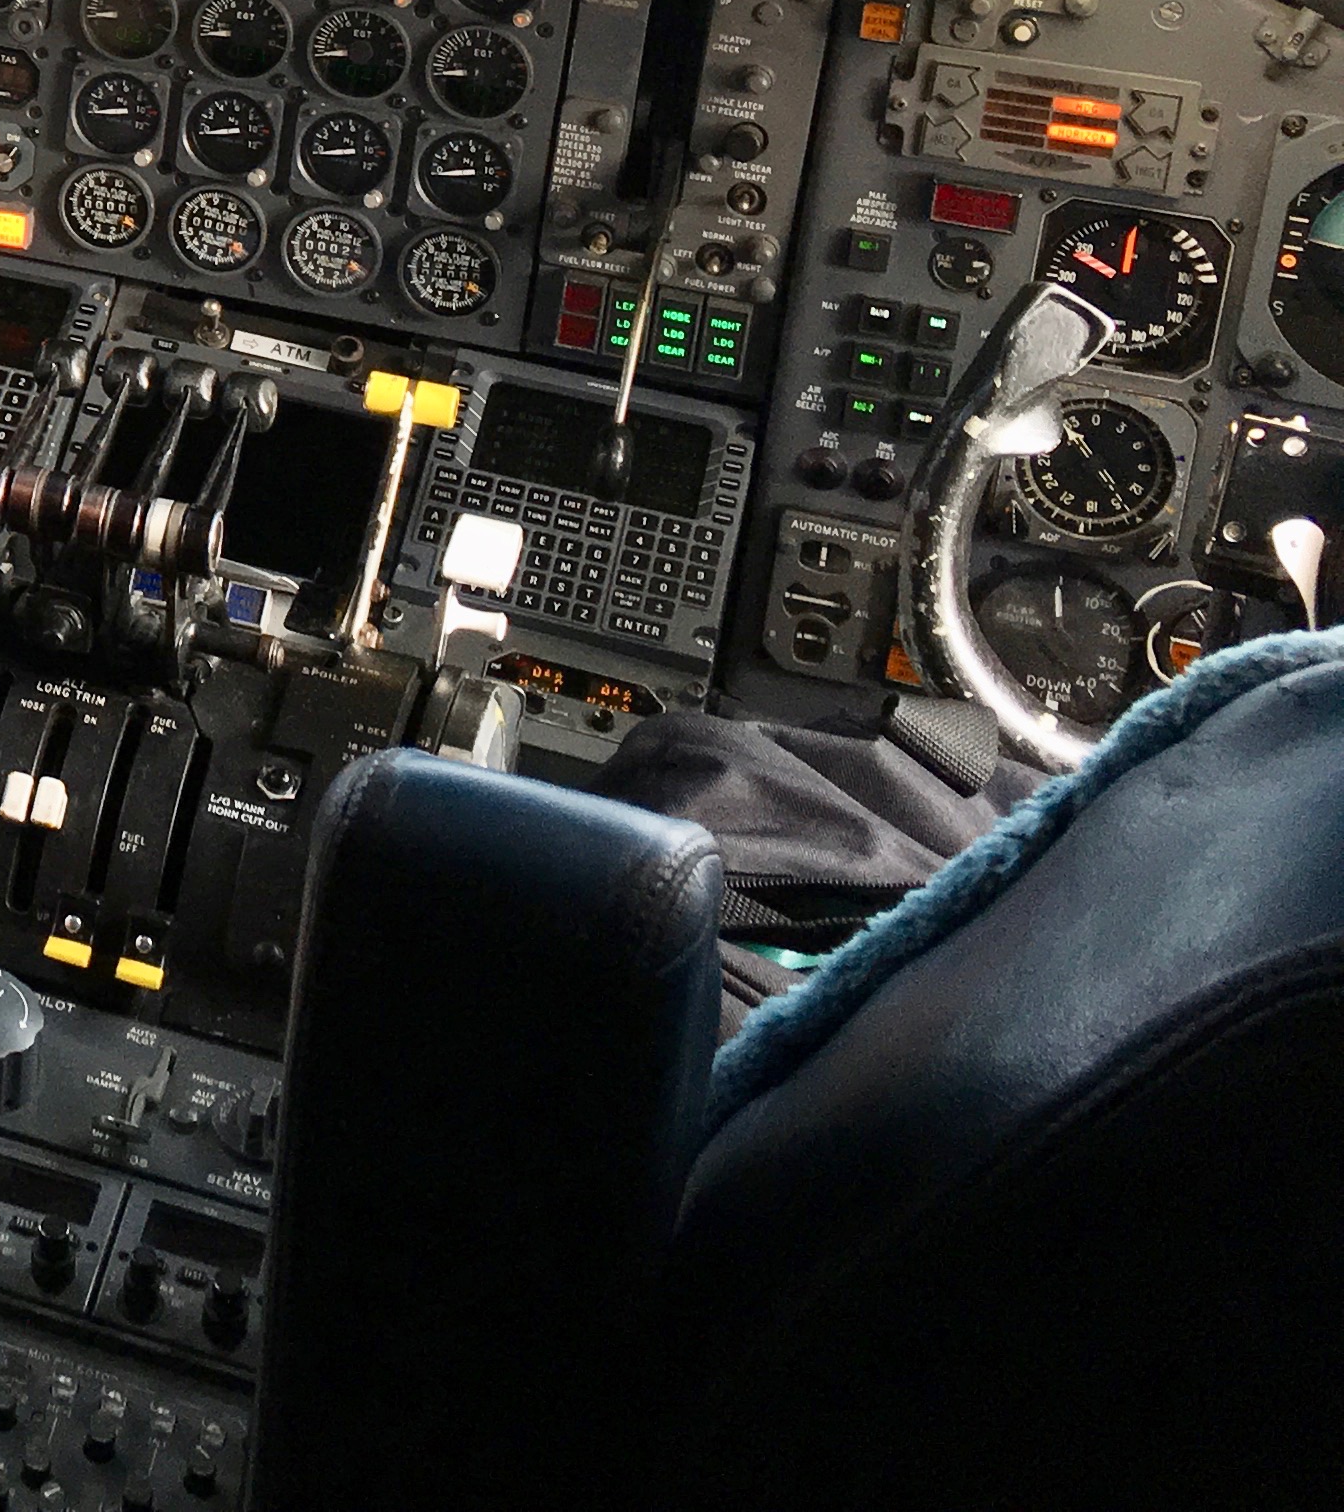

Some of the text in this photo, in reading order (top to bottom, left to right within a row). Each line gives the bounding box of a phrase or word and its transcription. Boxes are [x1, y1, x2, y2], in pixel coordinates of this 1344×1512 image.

[737, 100, 764, 111] LATCH
[718, 107, 756, 120] RELEASE
[561, 123, 577, 131] MAX
[559, 131, 590, 143] EXTEND
[1057, 127, 1107, 142] HORIZON
[558, 139, 584, 150] SPEED
[552, 175, 573, 185] OVER
[734, 171, 767, 183] UNSAFE
[868, 191, 887, 201] MAX
[856, 198, 897, 211] AIRSPEED
[856, 206, 895, 220] WARNING
[718, 215, 766, 231] LIGHT TEST
[702, 230, 735, 243] NORMAL
[673, 248, 693, 258] LEFT
[1075, 242, 1093, 254] 350
[559, 254, 578, 265] FUEL
[737, 262, 762, 273] RIGHT
[1057, 270, 1076, 283] 300
[1177, 272, 1193, 283] 100
[684, 277, 736, 294] FUEL POWER
[821, 300, 840, 311] NAV
[1177, 293, 1193, 306] 120
[1166, 311, 1183, 324] 140
[711, 318, 742, 332] RIGHT
[270, 342, 312, 361] ATM
[658, 344, 685, 357] GEAR
[813, 346, 832, 357] A/P
[707, 353, 735, 366] GEAR
[807, 385, 822, 394] AIR
[800, 392, 825, 403] DATA
[795, 400, 827, 413] SELECT
[819, 438, 840, 450] TEST
[875, 450, 896, 461] TEST
[439, 471, 458, 481] DATA
[594, 506, 616, 517] PREV
[589, 525, 611, 536] NEXT
[790, 518, 898, 549] AUTOMATIC PILOT
[615, 618, 661, 637] ENTER
[1026, 674, 1072, 694] DOWN
[36, 680, 106, 707] LONG TRIM
[20, 698, 45, 713] NOSE
[152, 715, 178, 731] FUEL
[210, 793, 265, 816] L/G WARN
[122, 830, 146, 846] FUEL
[119, 841, 138, 854] OFF
[233, 1169, 262, 1186] NAV
